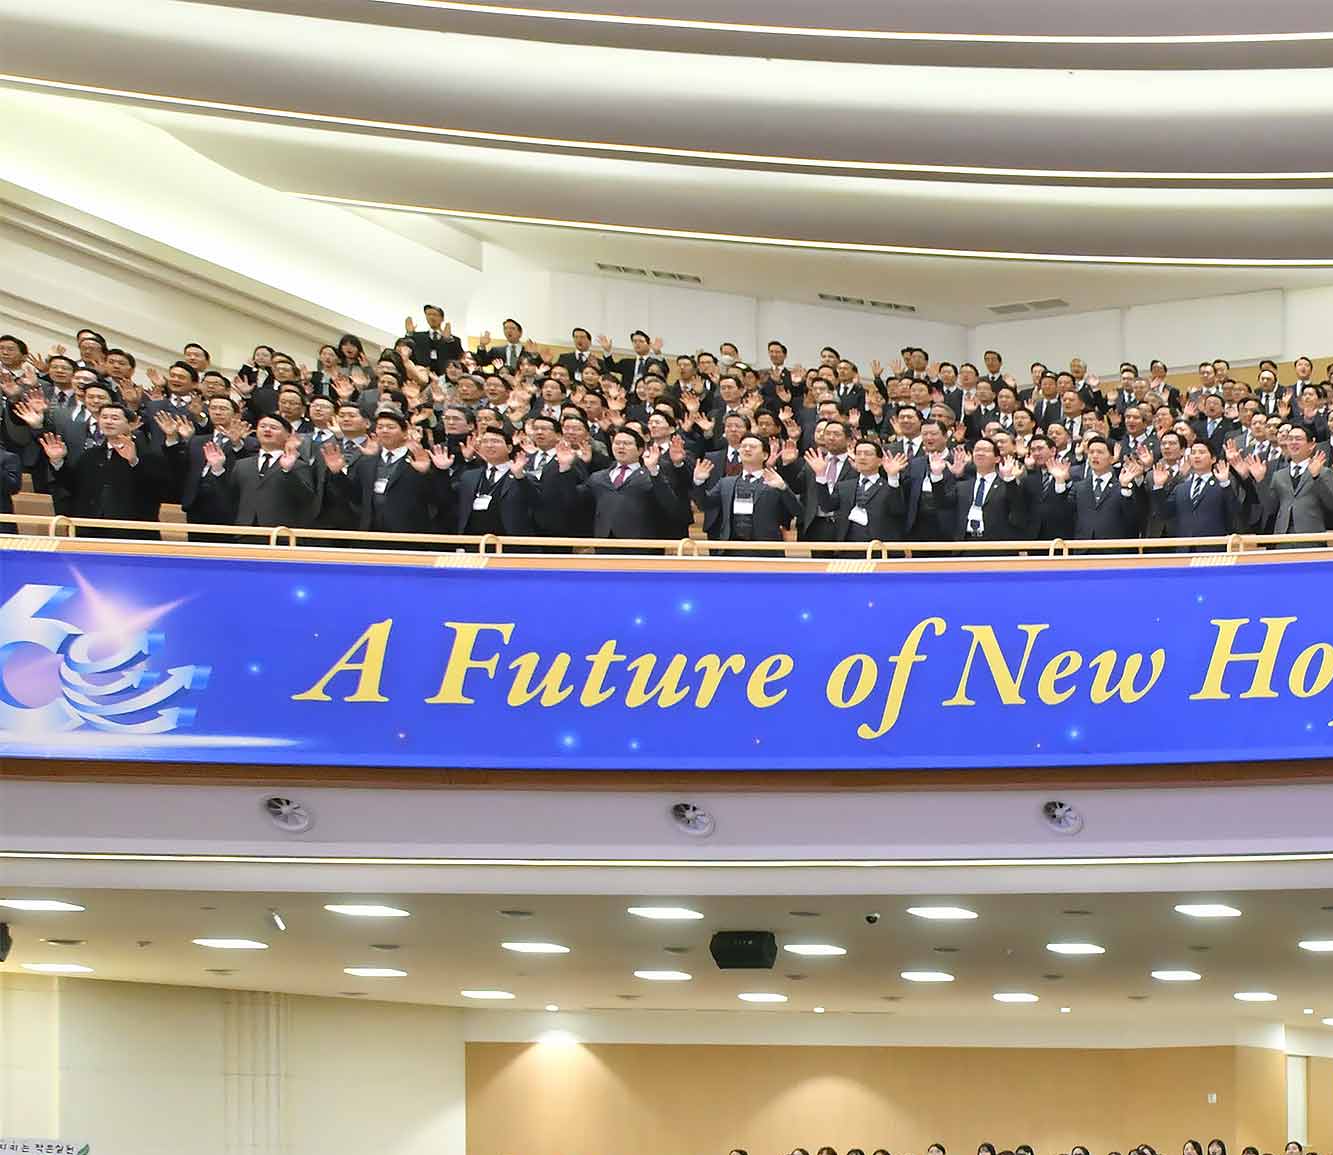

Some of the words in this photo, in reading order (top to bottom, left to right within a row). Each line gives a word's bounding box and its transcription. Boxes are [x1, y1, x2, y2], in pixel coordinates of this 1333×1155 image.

[291, 617, 395, 704] A
[425, 620, 790, 708] Future
[825, 616, 947, 741] of
[941, 622, 1166, 706] New
